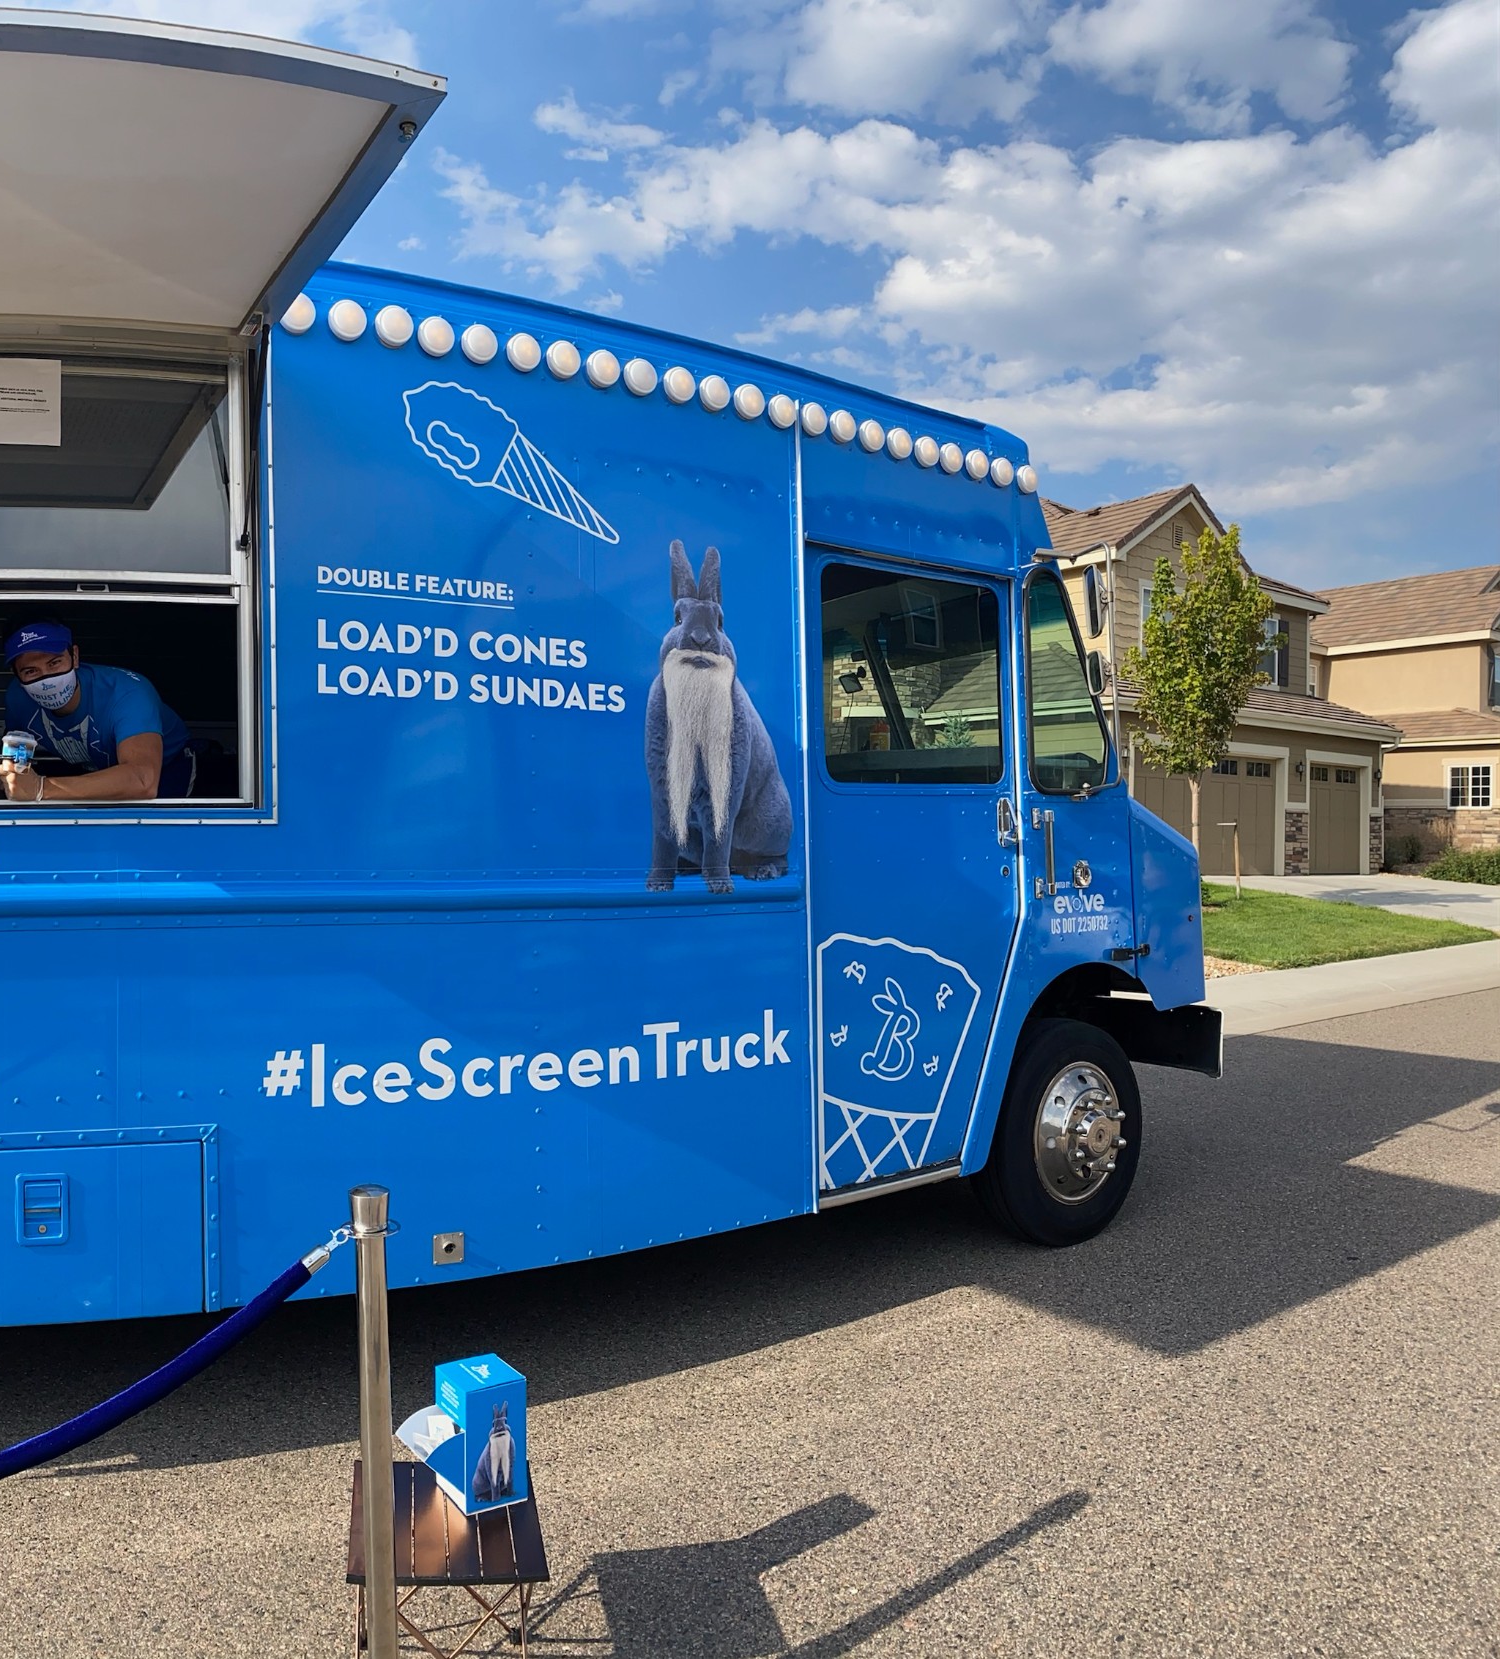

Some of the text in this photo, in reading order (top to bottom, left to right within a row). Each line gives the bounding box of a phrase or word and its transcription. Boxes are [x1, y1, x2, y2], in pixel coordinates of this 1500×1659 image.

[317, 565, 514, 602] DOUBLE FEATURE:
[468, 630, 588, 669] CONES
[468, 673, 627, 713] SUNDAES
[1054, 888, 1105, 914] evolve
[1051, 915, 1109, 934] US DOT 2250732
[262, 1009, 792, 1108] #IceScreenTruck
